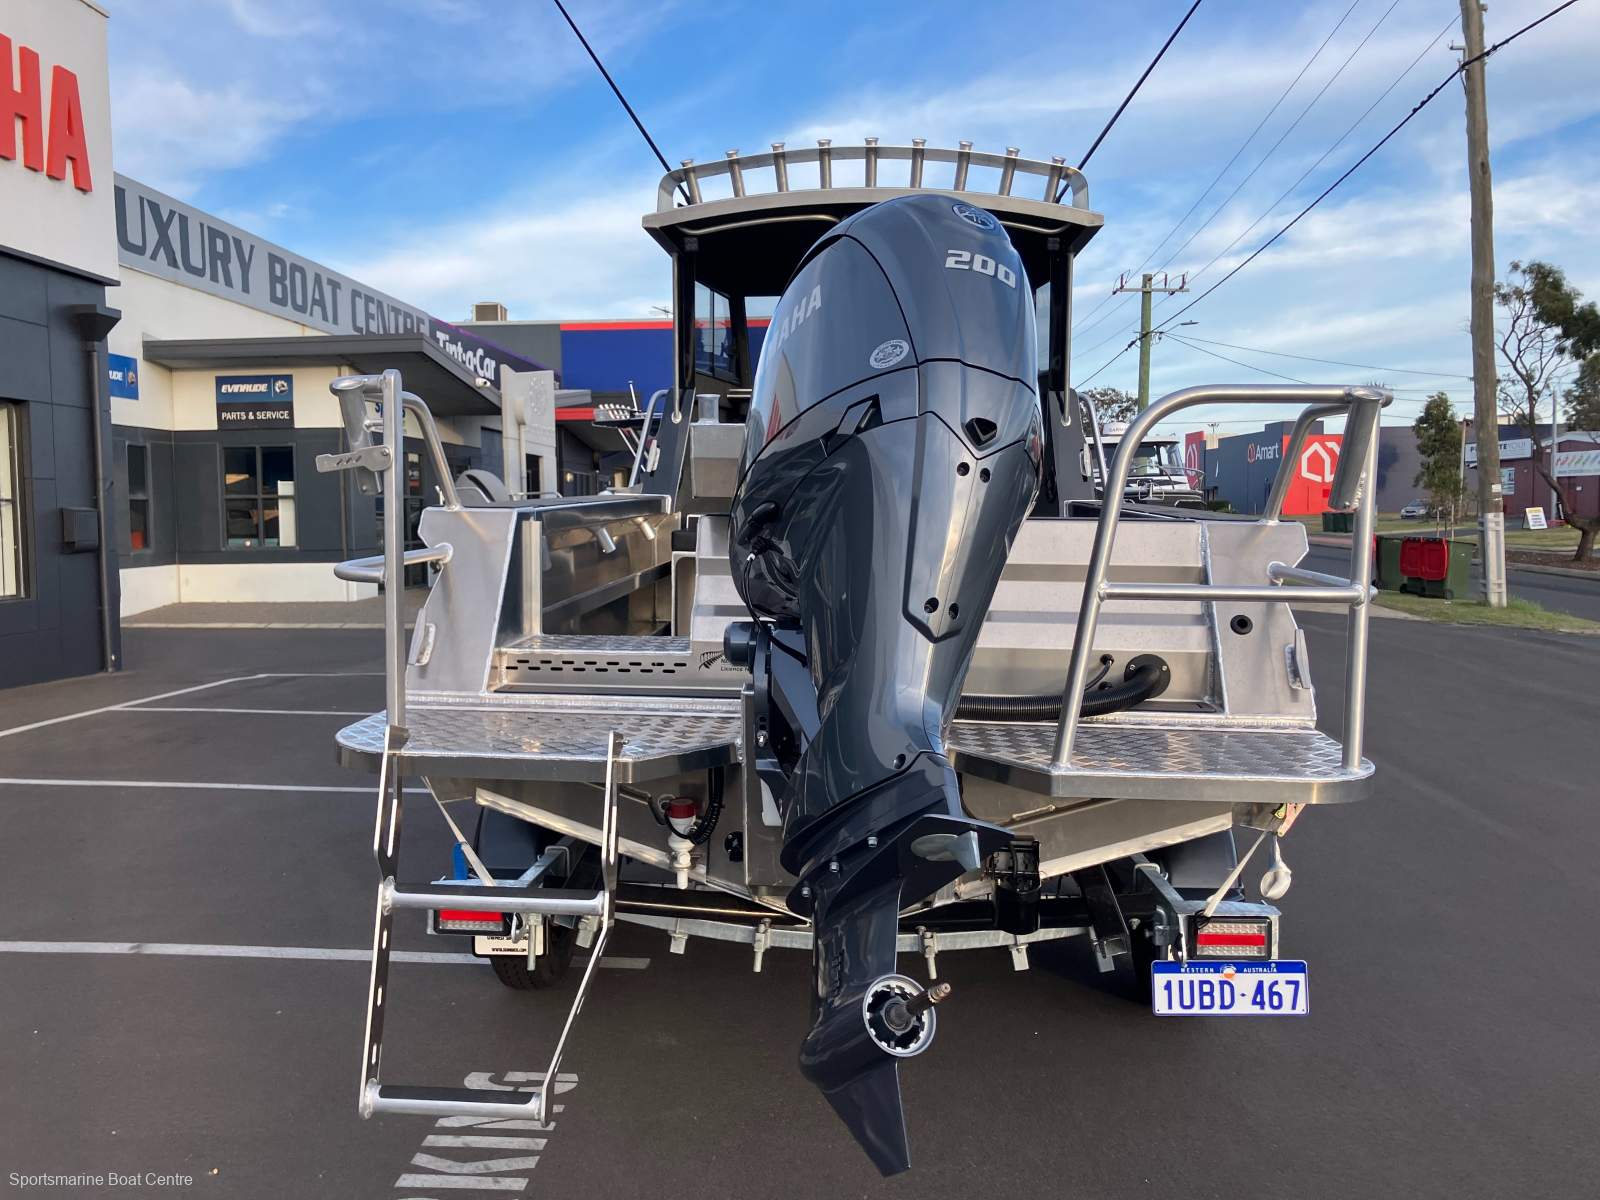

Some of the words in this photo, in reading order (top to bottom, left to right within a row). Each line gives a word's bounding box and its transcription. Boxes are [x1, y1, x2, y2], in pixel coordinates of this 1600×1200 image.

[114, 184, 255, 294] UXURY
[267, 252, 341, 326] BOAT
[945, 249, 1016, 289] 200
[221, 384, 268, 393] EVINRUDE
[222, 411, 246, 420] PARTS
[248, 411, 255, 420] &
[256, 410, 290, 420] SERVICE
[1255, 442, 1279, 460] Amart
